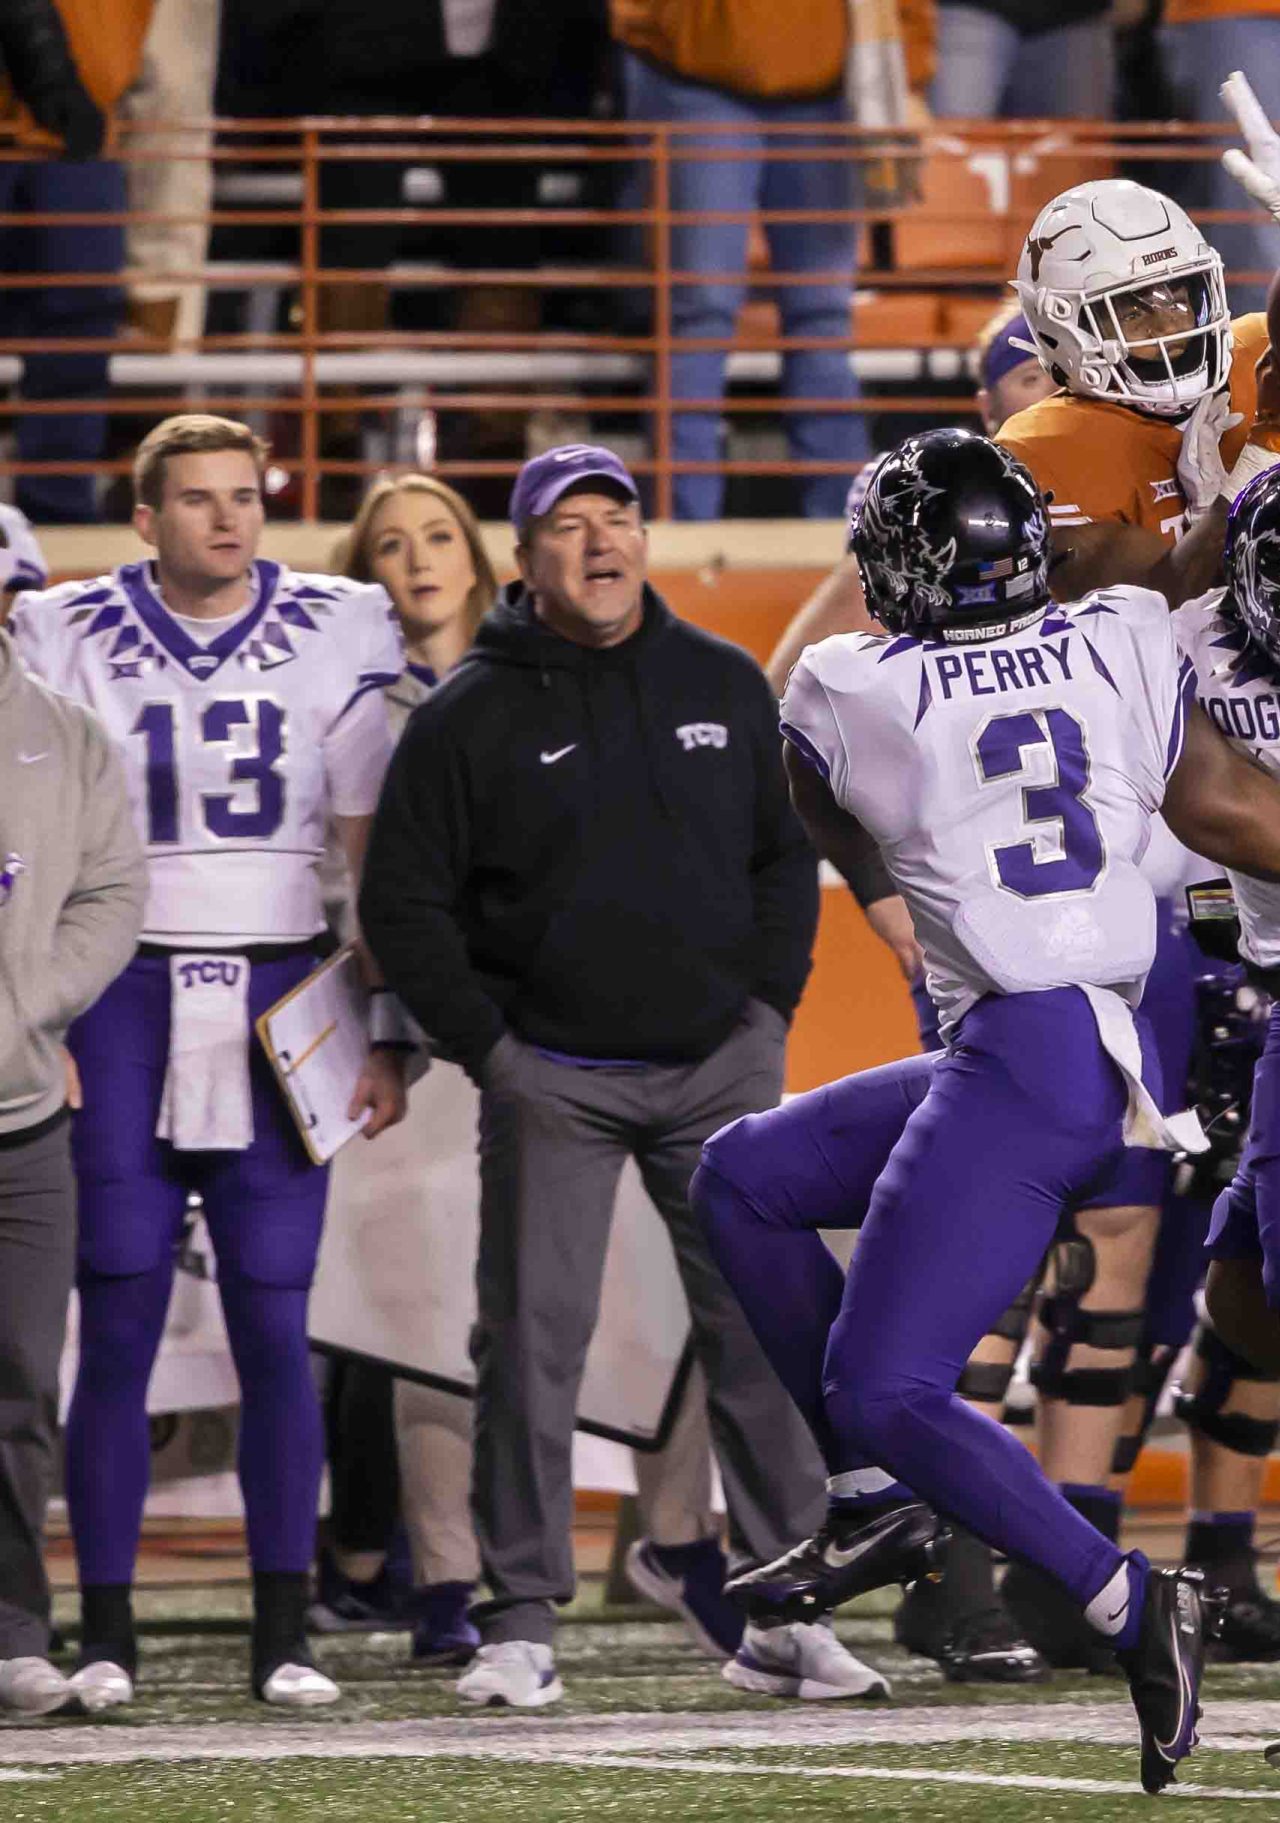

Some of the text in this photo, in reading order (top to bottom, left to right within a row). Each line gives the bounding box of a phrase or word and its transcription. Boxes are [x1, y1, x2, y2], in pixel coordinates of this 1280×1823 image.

[1141, 246, 1179, 266] HORNS
[1017, 557, 1028, 572] 12
[942, 624, 1006, 641] HORNED
[935, 637, 1073, 700] PERRY
[676, 722, 728, 751] TCU
[129, 698, 287, 845] 13
[968, 704, 1108, 902] 3
[178, 961, 241, 988] TCU
